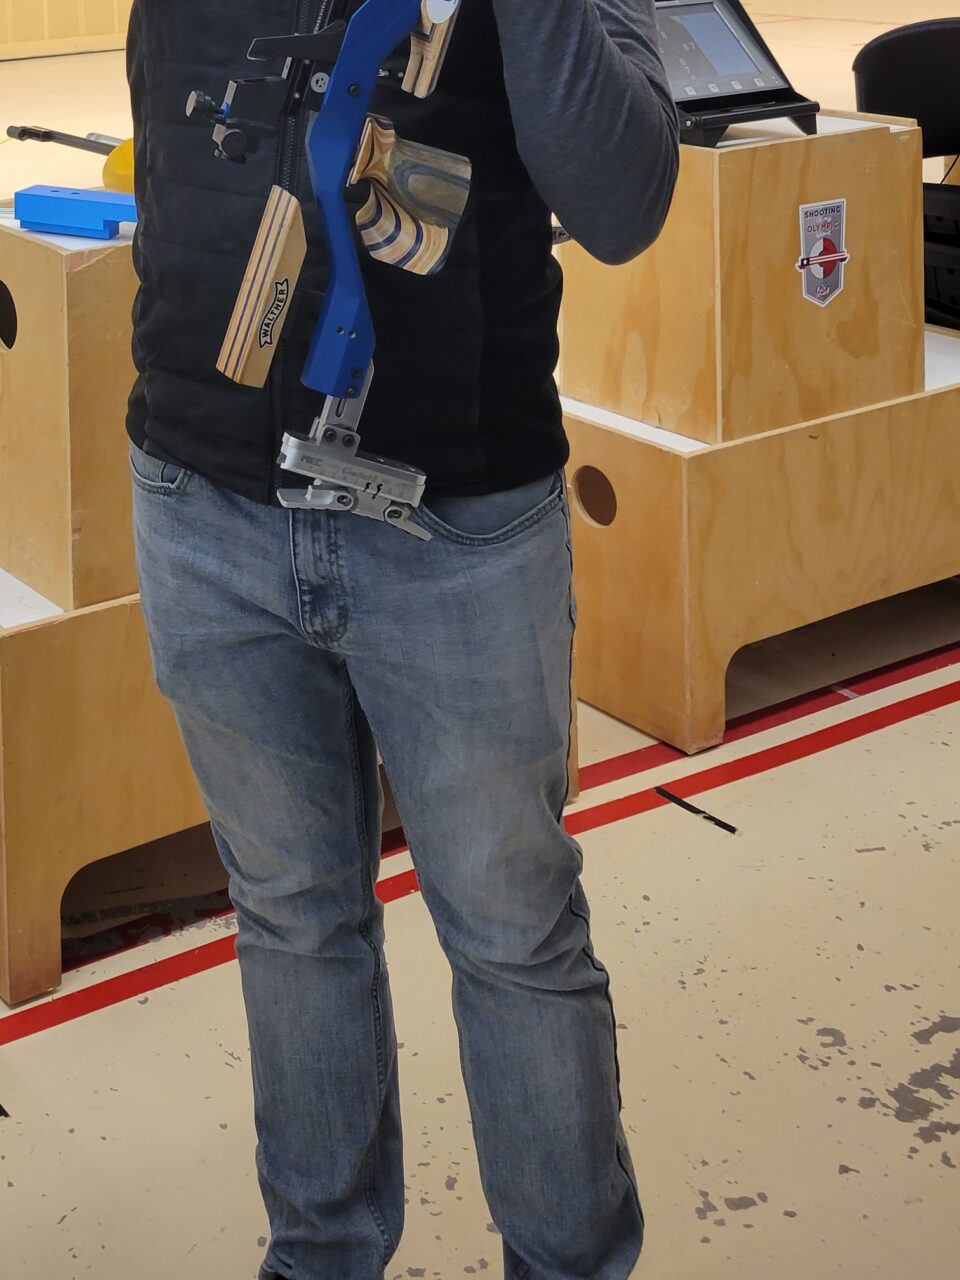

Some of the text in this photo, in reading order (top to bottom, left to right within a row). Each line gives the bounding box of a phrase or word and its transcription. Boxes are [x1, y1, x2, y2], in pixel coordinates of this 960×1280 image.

[804, 206, 841, 219] SHOOTING
[807, 220, 839, 233] OLYMPIC
[262, 288, 286, 339] WALTHER
